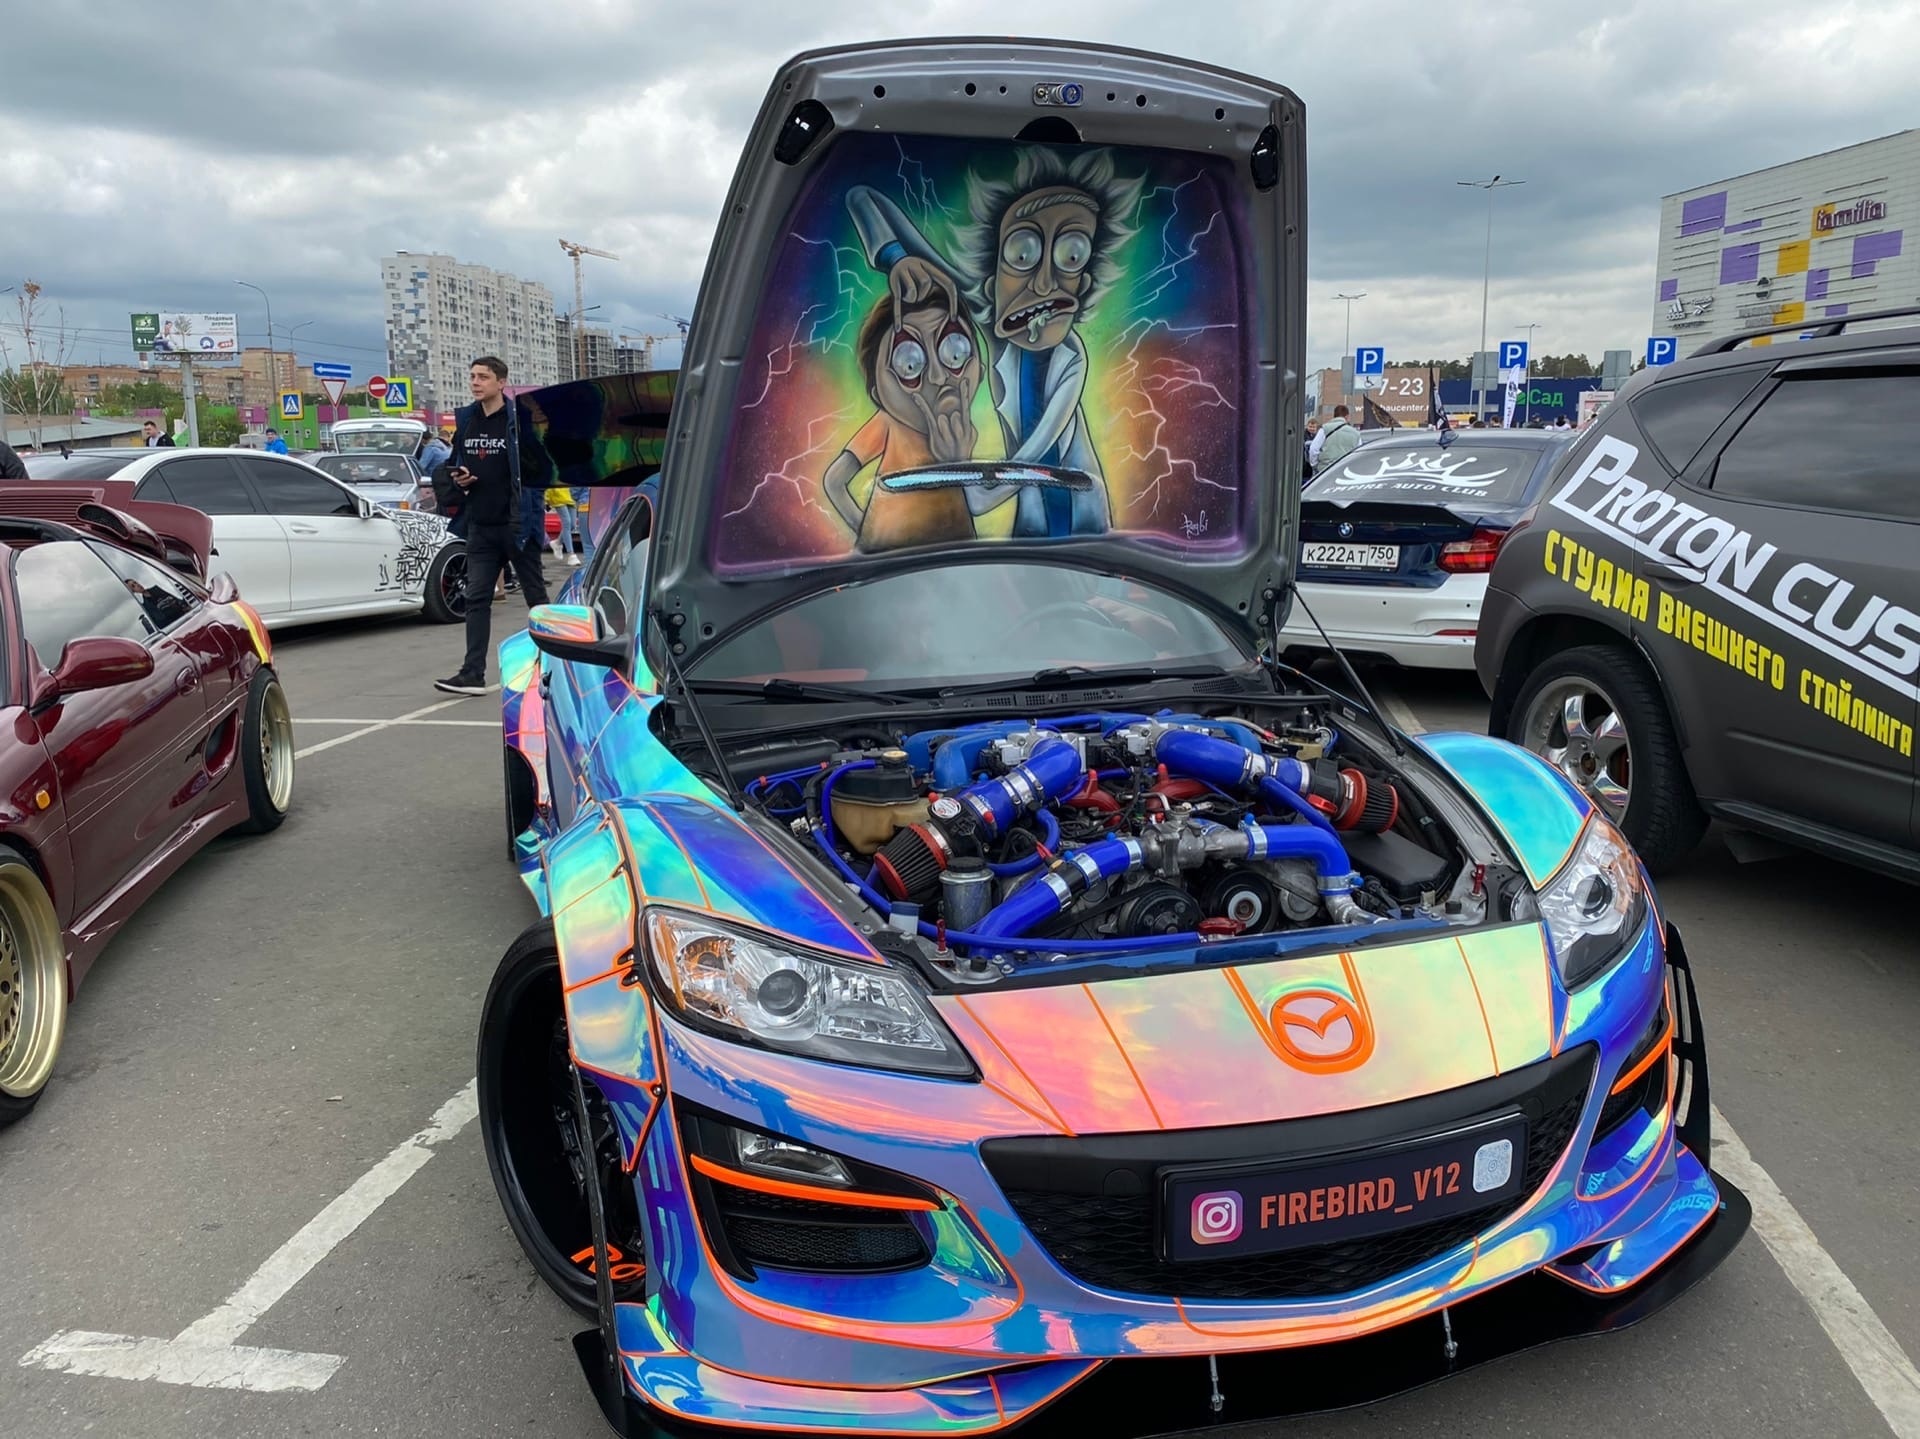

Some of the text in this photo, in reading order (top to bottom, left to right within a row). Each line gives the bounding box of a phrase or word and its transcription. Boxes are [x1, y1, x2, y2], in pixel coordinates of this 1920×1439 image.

[1817, 199, 1886, 231] familia
[1530, 388, 1564, 407] Сад
[1322, 483, 1489, 497] EMPIRE AUTO CLUB
[1549, 434, 1778, 593] PROTON
[1370, 546, 1394, 560] 750
[1543, 529, 1913, 757] СТУДИЯ ВНЕШНЕГО СТАЙЛИНГА
[1259, 1161, 1461, 1230] FIREBIRD_V12
